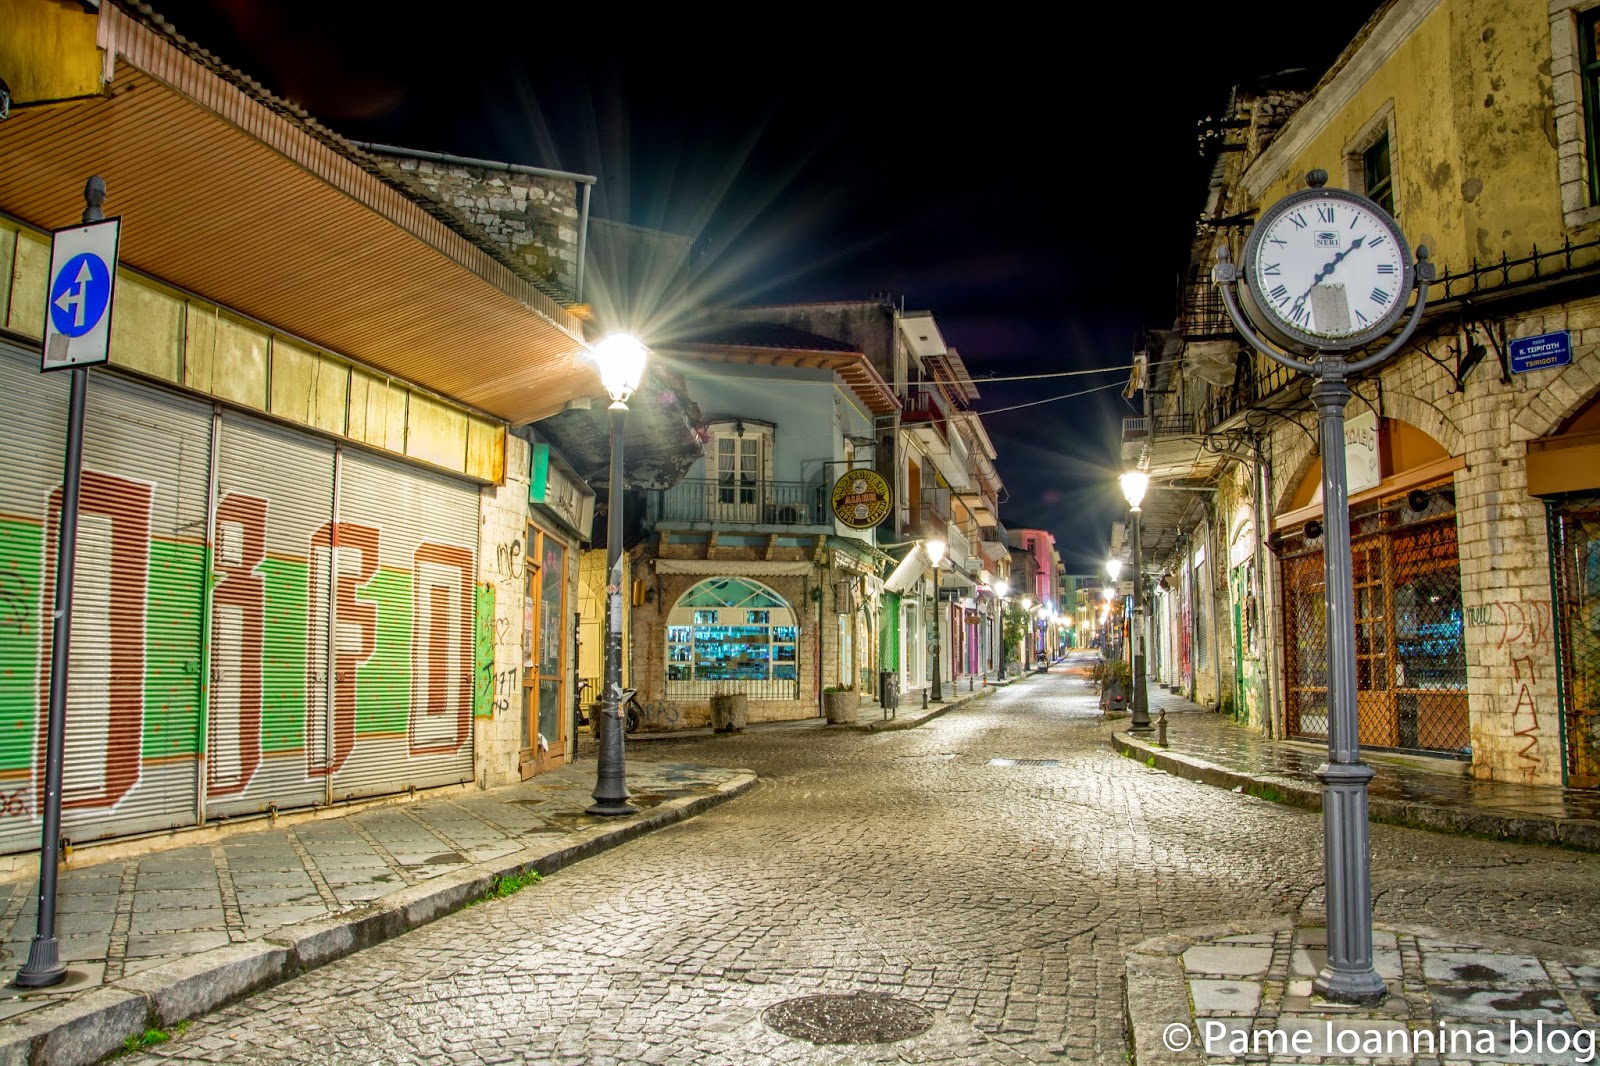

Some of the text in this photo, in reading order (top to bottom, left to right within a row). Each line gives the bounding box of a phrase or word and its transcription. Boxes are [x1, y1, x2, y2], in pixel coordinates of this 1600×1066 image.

[1317, 207, 1334, 223] XII
[1289, 213, 1307, 231] XI
[1269, 235, 1287, 249] X
[1368, 236, 1384, 248] II
[1264, 262, 1281, 275] IX
[1377, 264, 1394, 274] III
[1270, 284, 1291, 308] VIII
[1526, 342, 1560, 354] ΤΣΙΡΙΓΩΤΗ
[1525, 356, 1557, 367] TSIRIGOTI
[866, 501, 887, 523] ΚΑΡΠΟΙ
